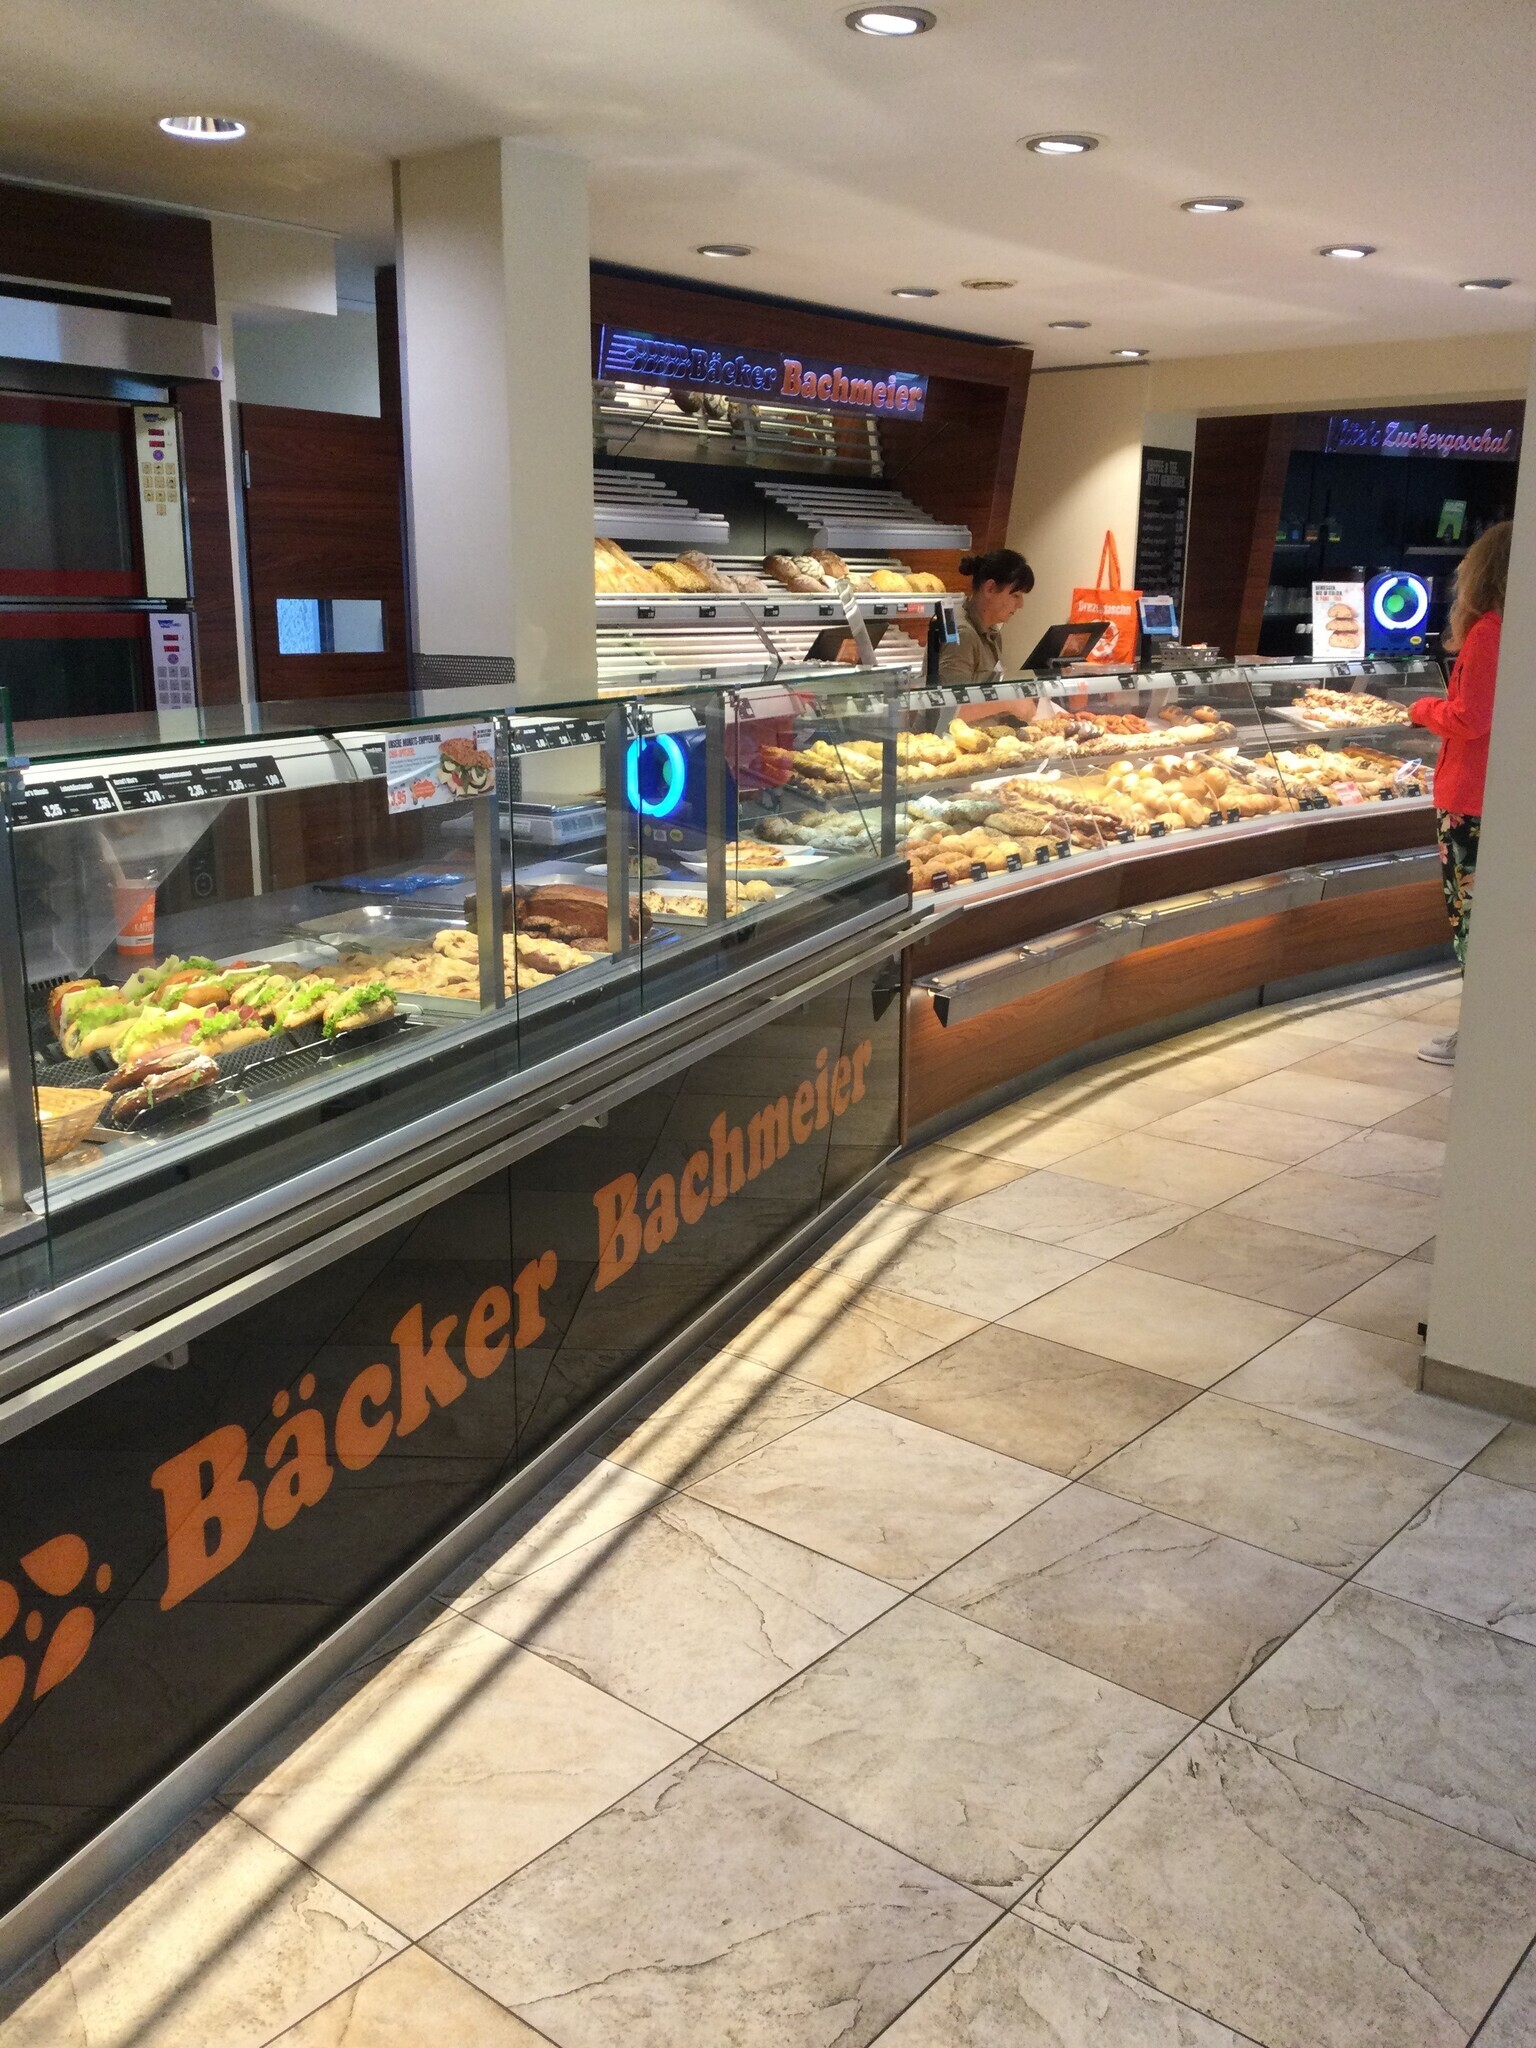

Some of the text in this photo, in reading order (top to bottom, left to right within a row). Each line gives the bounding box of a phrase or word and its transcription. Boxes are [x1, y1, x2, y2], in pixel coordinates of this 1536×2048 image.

[689, 347, 923, 412] Bäcker Bachmeier
[1382, 421, 1513, 458] Zuckergoschal
[42, 803, 63, 818] 3,25
[151, 1037, 873, 1613] Bäcker Bachmeier
